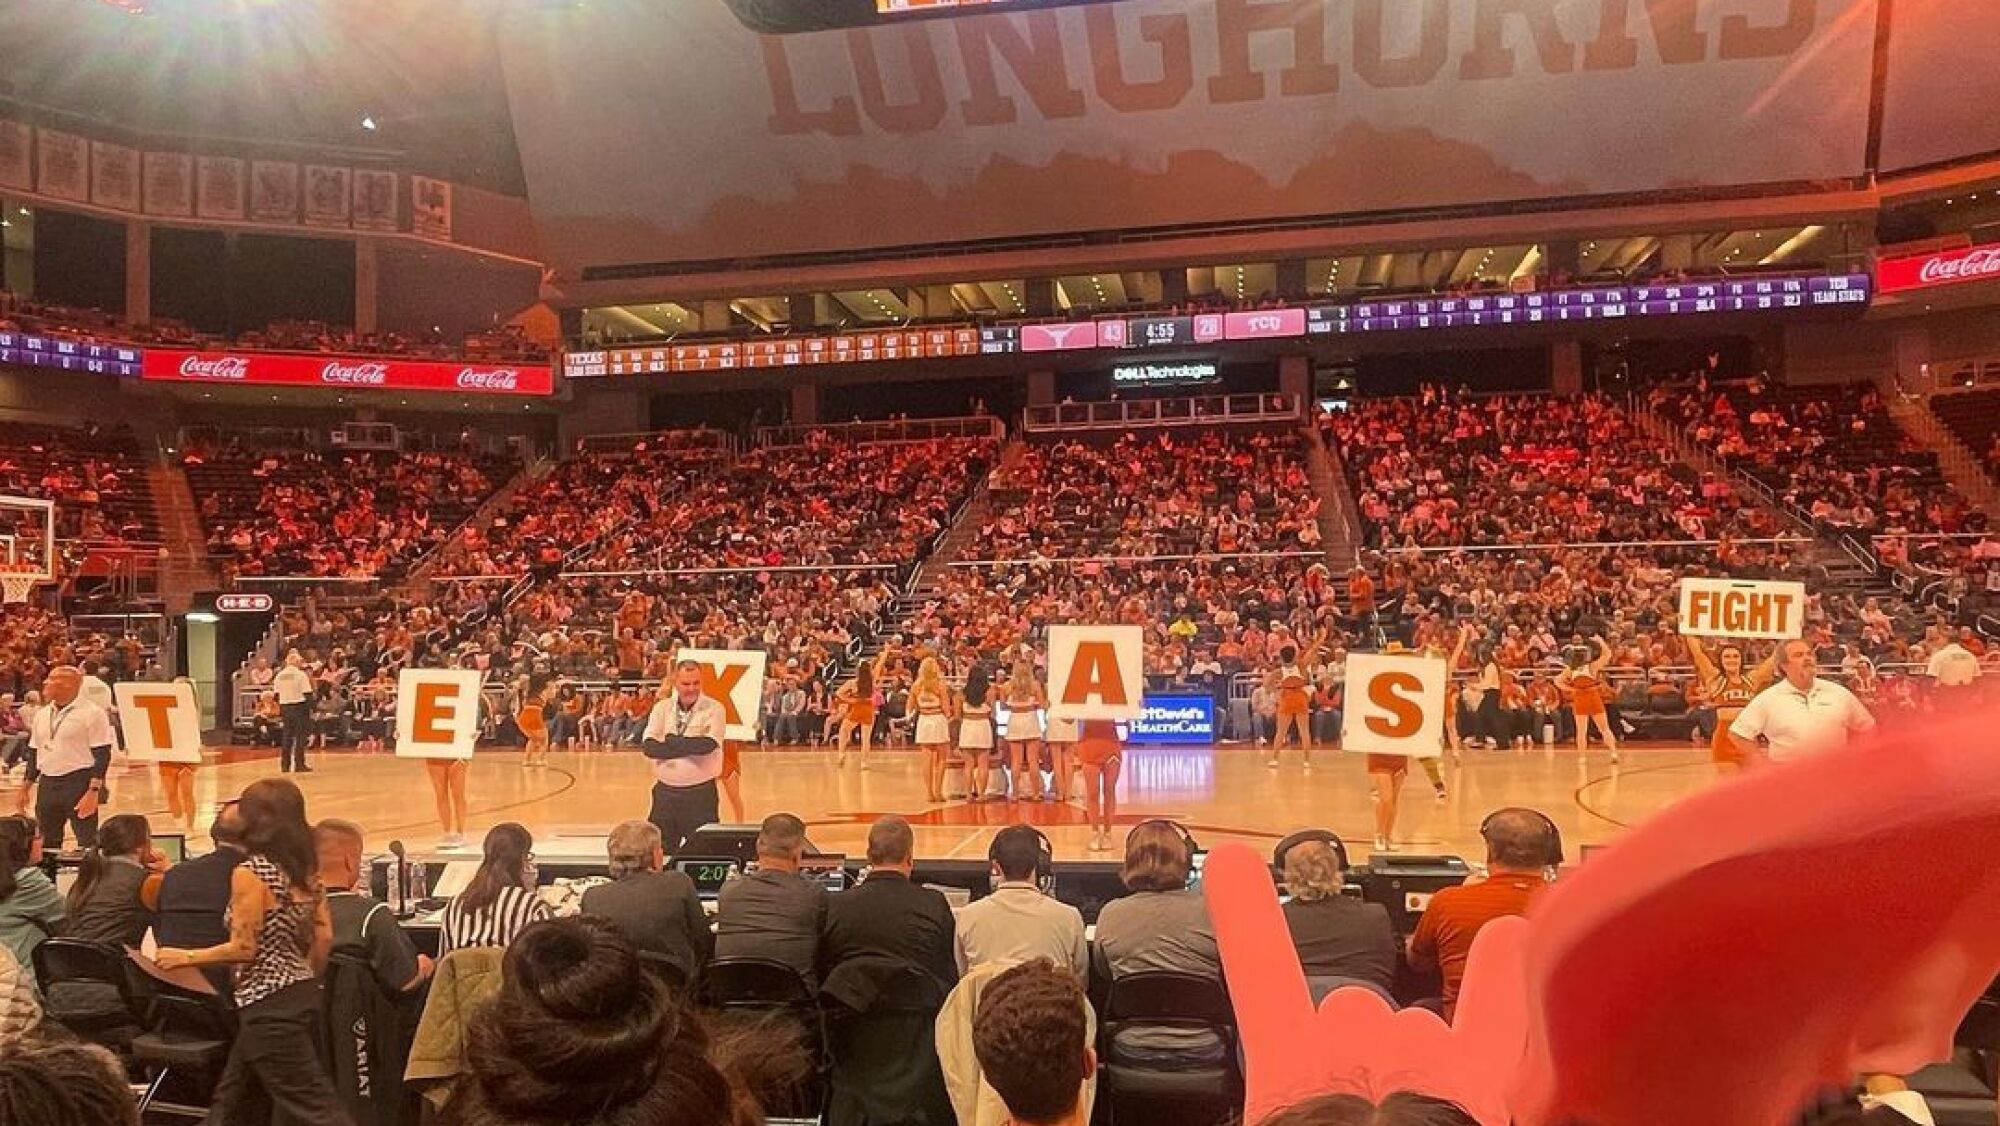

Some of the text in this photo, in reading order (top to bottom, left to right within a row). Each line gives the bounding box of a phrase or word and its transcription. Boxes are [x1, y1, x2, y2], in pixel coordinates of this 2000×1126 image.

[1145, 324, 1175, 338] 4:55
[1248, 316, 1281, 333] TCU
[1688, 590, 1794, 633] FIGHT
[1061, 641, 1128, 705] A
[133, 694, 179, 749] T
[413, 683, 460, 743] E
[1364, 671, 1425, 738] S
[356, 1038, 372, 1099] ARIAT
